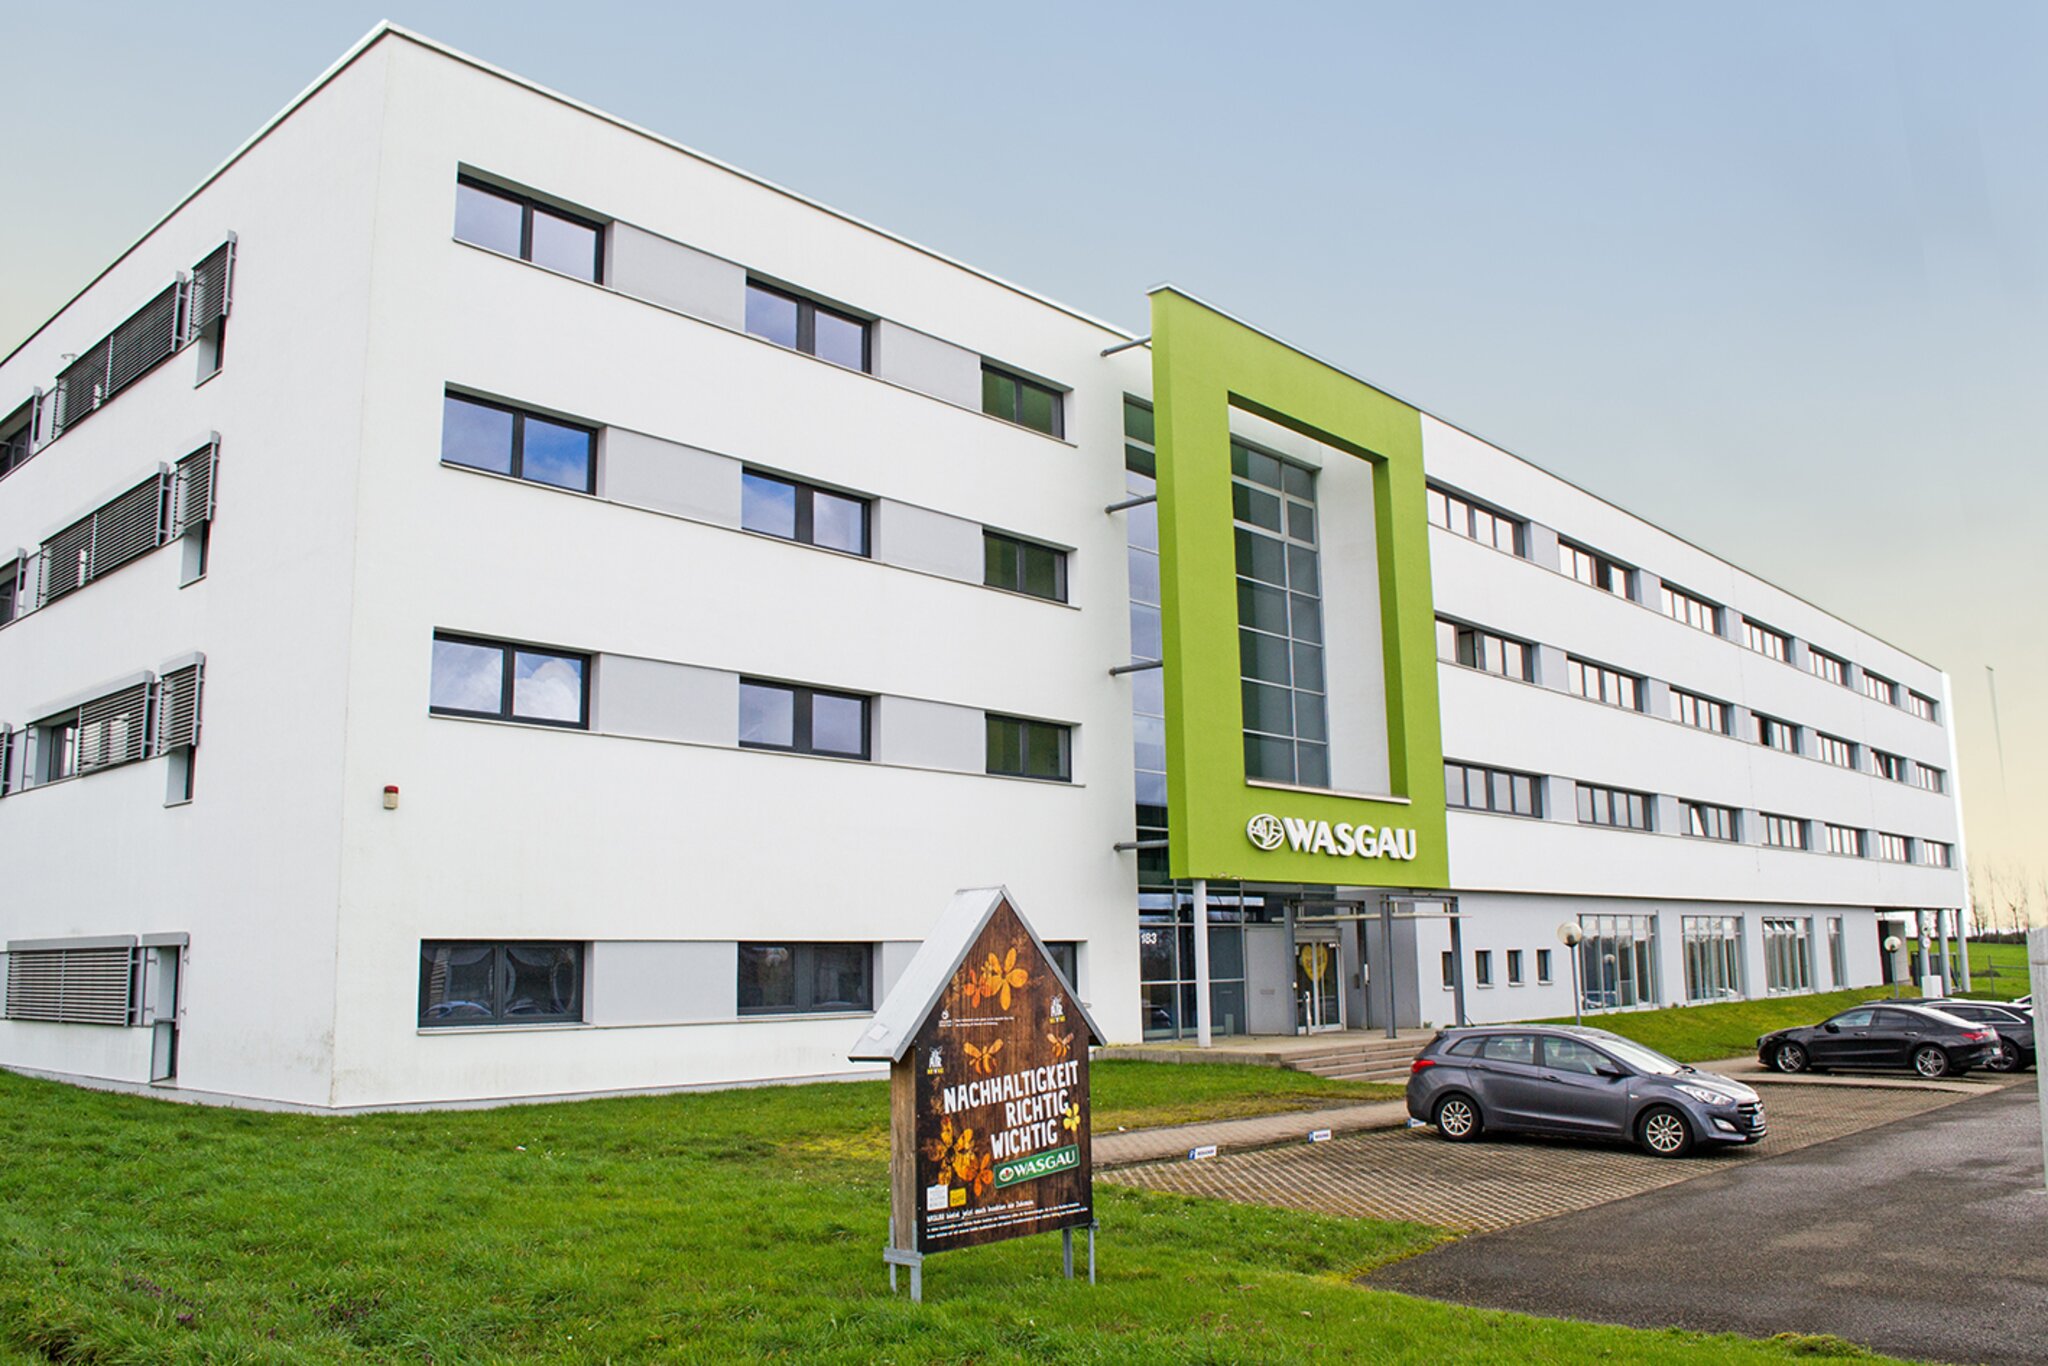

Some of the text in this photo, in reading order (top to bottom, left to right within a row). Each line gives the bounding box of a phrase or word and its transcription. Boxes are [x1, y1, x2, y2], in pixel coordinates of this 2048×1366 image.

[1281, 816, 1417, 861] WASGAU
[943, 1060, 1079, 1114] NACHHALTIGKEIT
[1005, 1089, 1069, 1128] RICHTIG
[990, 1119, 1058, 1160] WICHTIG
[1013, 1150, 1076, 1177] WASGAU
